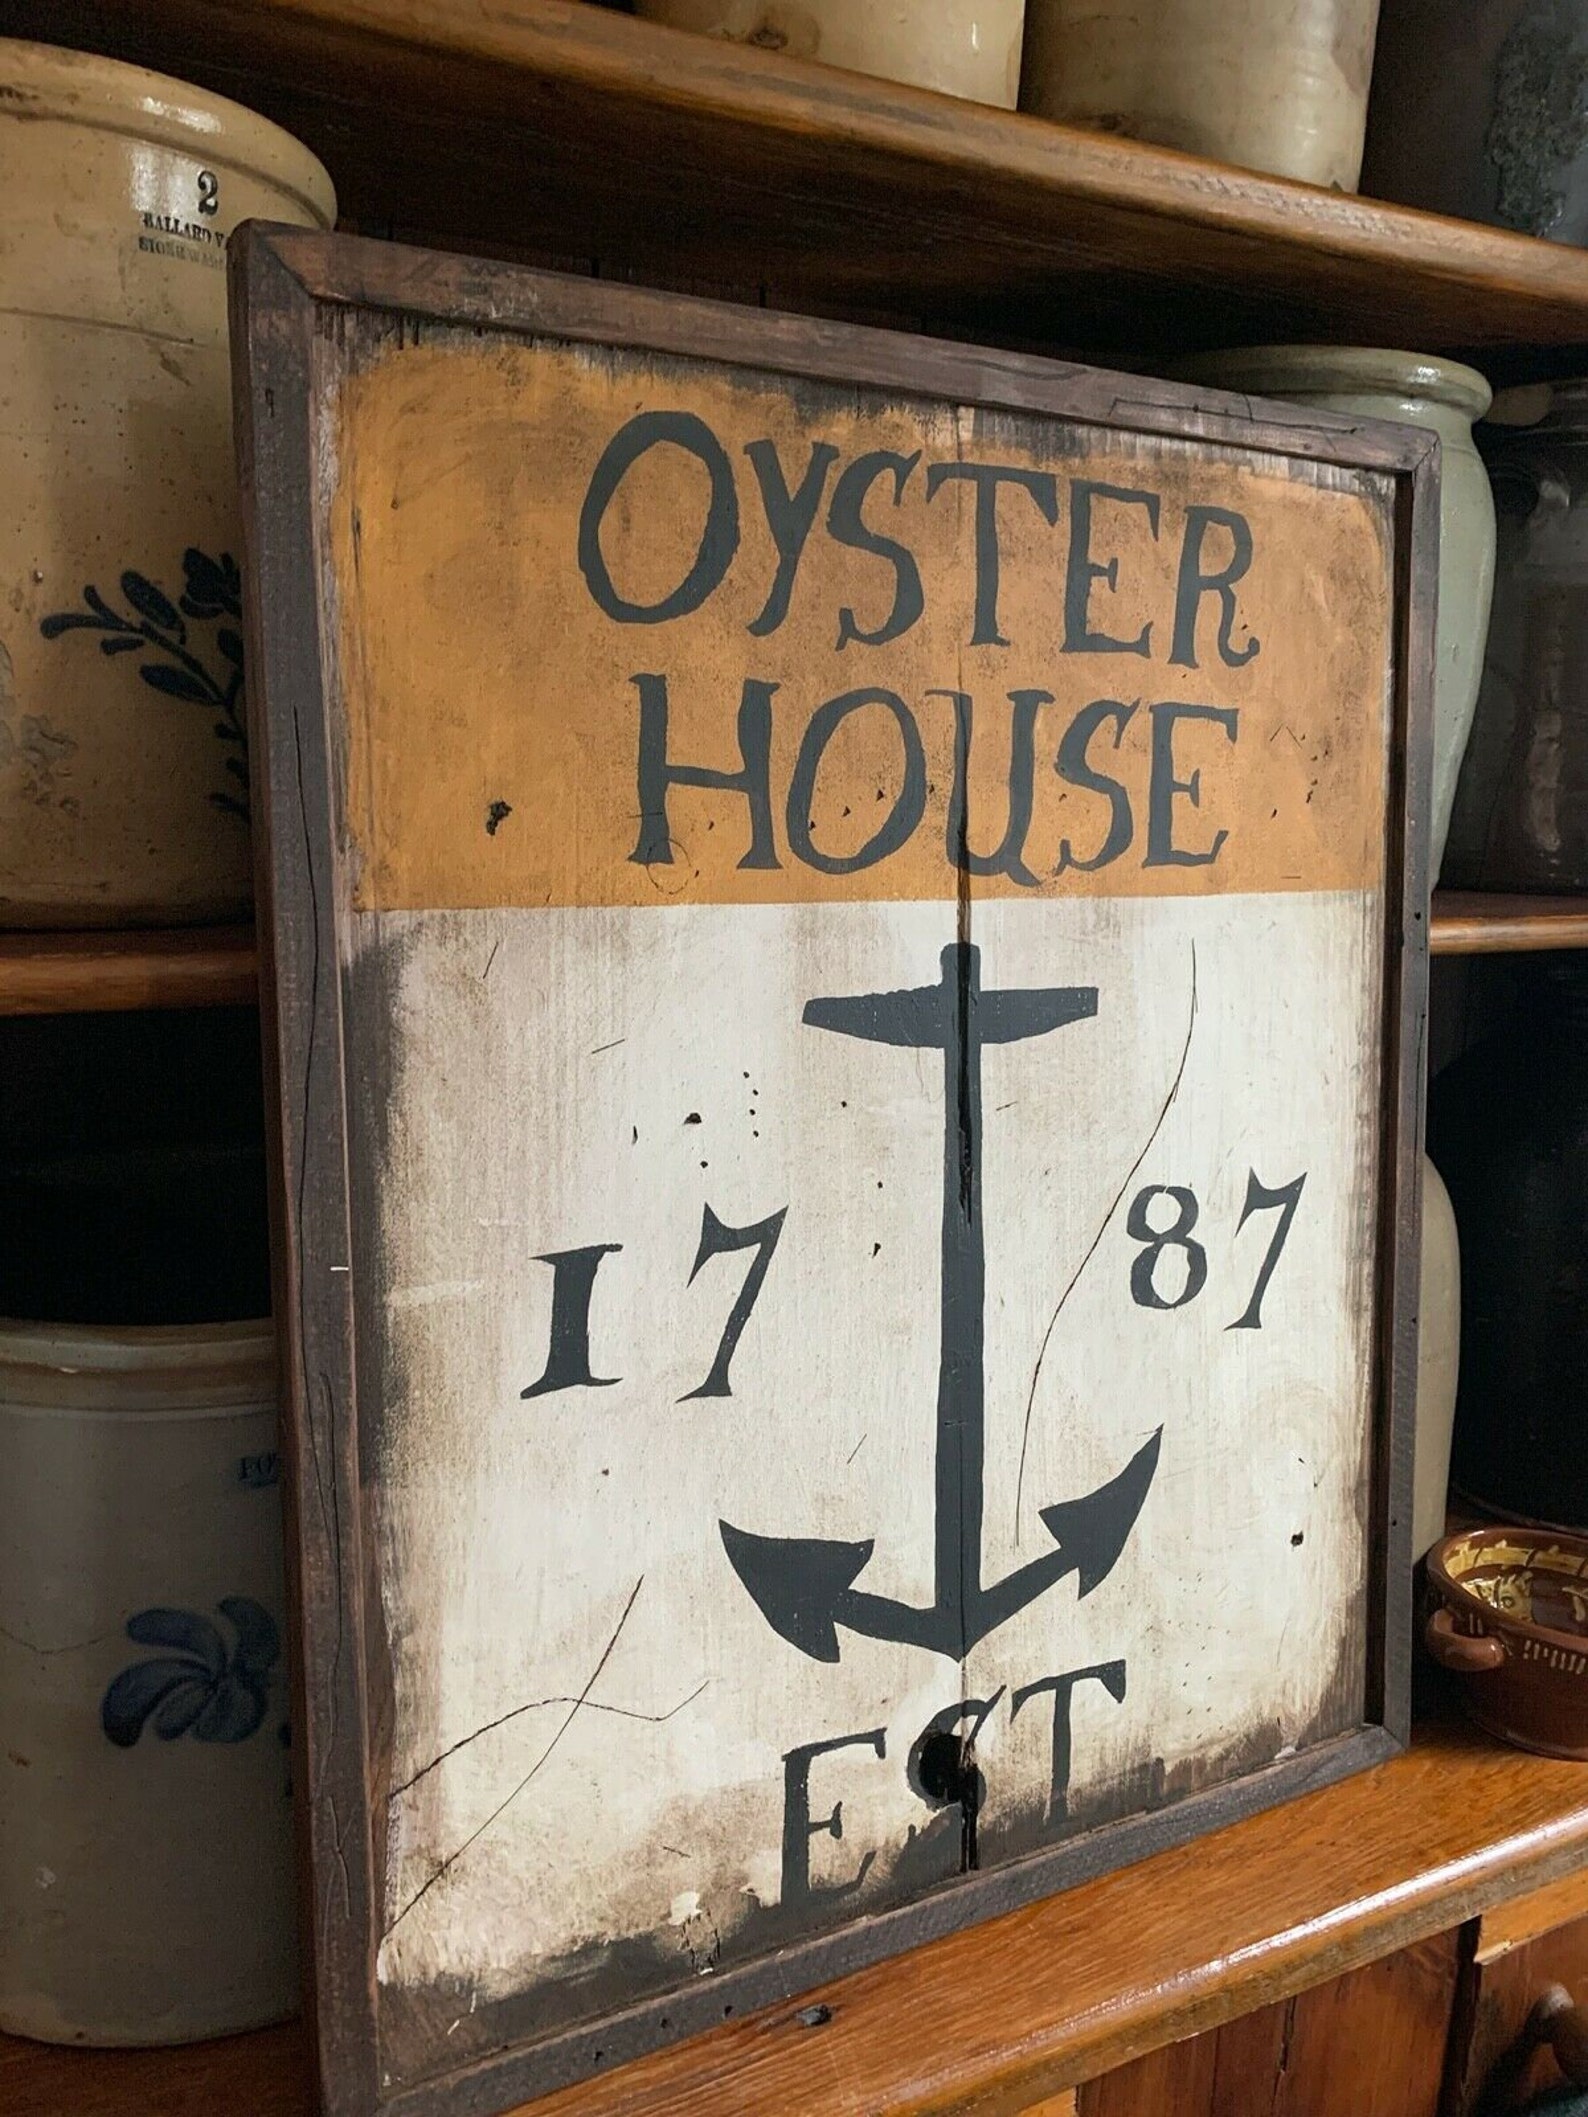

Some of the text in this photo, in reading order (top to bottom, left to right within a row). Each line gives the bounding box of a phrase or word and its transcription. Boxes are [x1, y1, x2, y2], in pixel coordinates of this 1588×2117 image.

[142, 212, 213, 244] BALLARD
[197, 170, 219, 216] 2
[577, 410, 1261, 669] OYSTER
[627, 673, 1239, 886] HOUSE
[1124, 1166, 1307, 1332] 87
[780, 1659, 1127, 1906] EST
